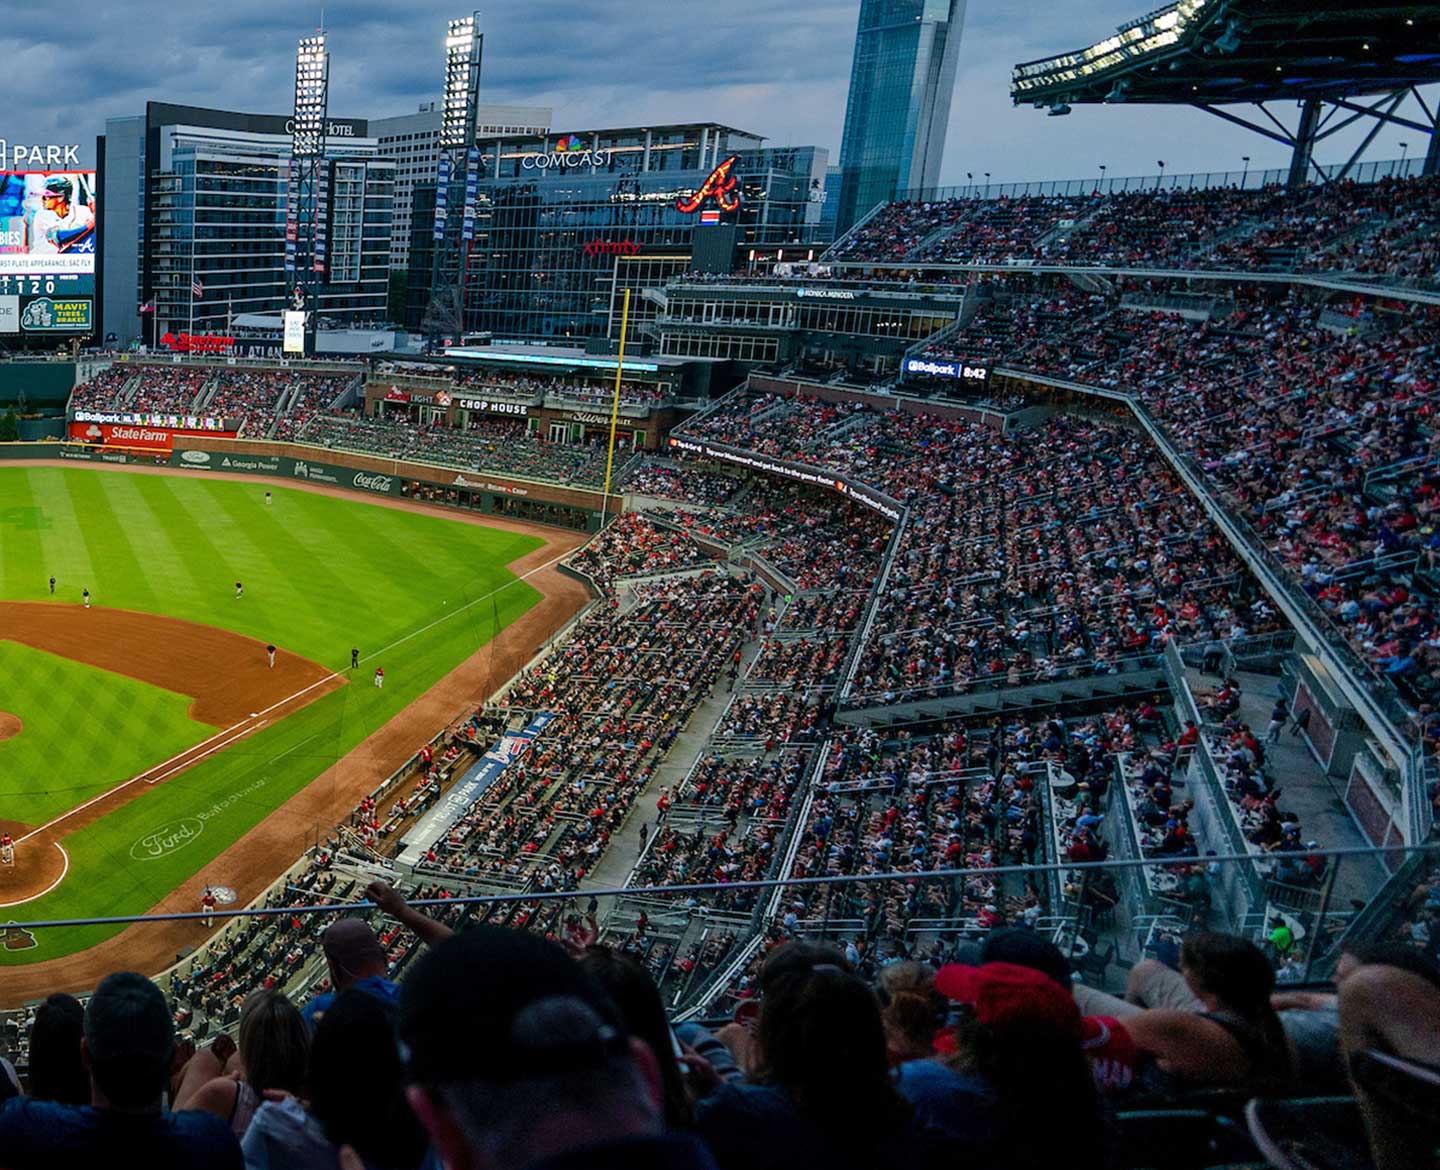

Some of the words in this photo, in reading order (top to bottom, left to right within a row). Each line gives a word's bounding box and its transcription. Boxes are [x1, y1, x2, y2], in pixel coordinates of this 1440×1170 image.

[14, 144, 80, 165] PARK
[522, 150, 611, 170] COMCAST
[583, 239, 641, 256] xfinity
[12, 259, 29, 267] PLATE
[17, 282, 23, 294] 1
[31, 282, 40, 294] 2
[45, 282, 55, 294] 0
[53, 303, 88, 311] MAVIS
[918, 361, 955, 375] Ballpark
[963, 366, 986, 380] 8:42
[460, 399, 488, 410] CHOP
[491, 402, 528, 415] HOUSE
[84, 411, 121, 423] Ballpark
[232, 459, 257, 470] Georgia
[258, 461, 278, 471] Power
[142, 824, 195, 856] Ford
